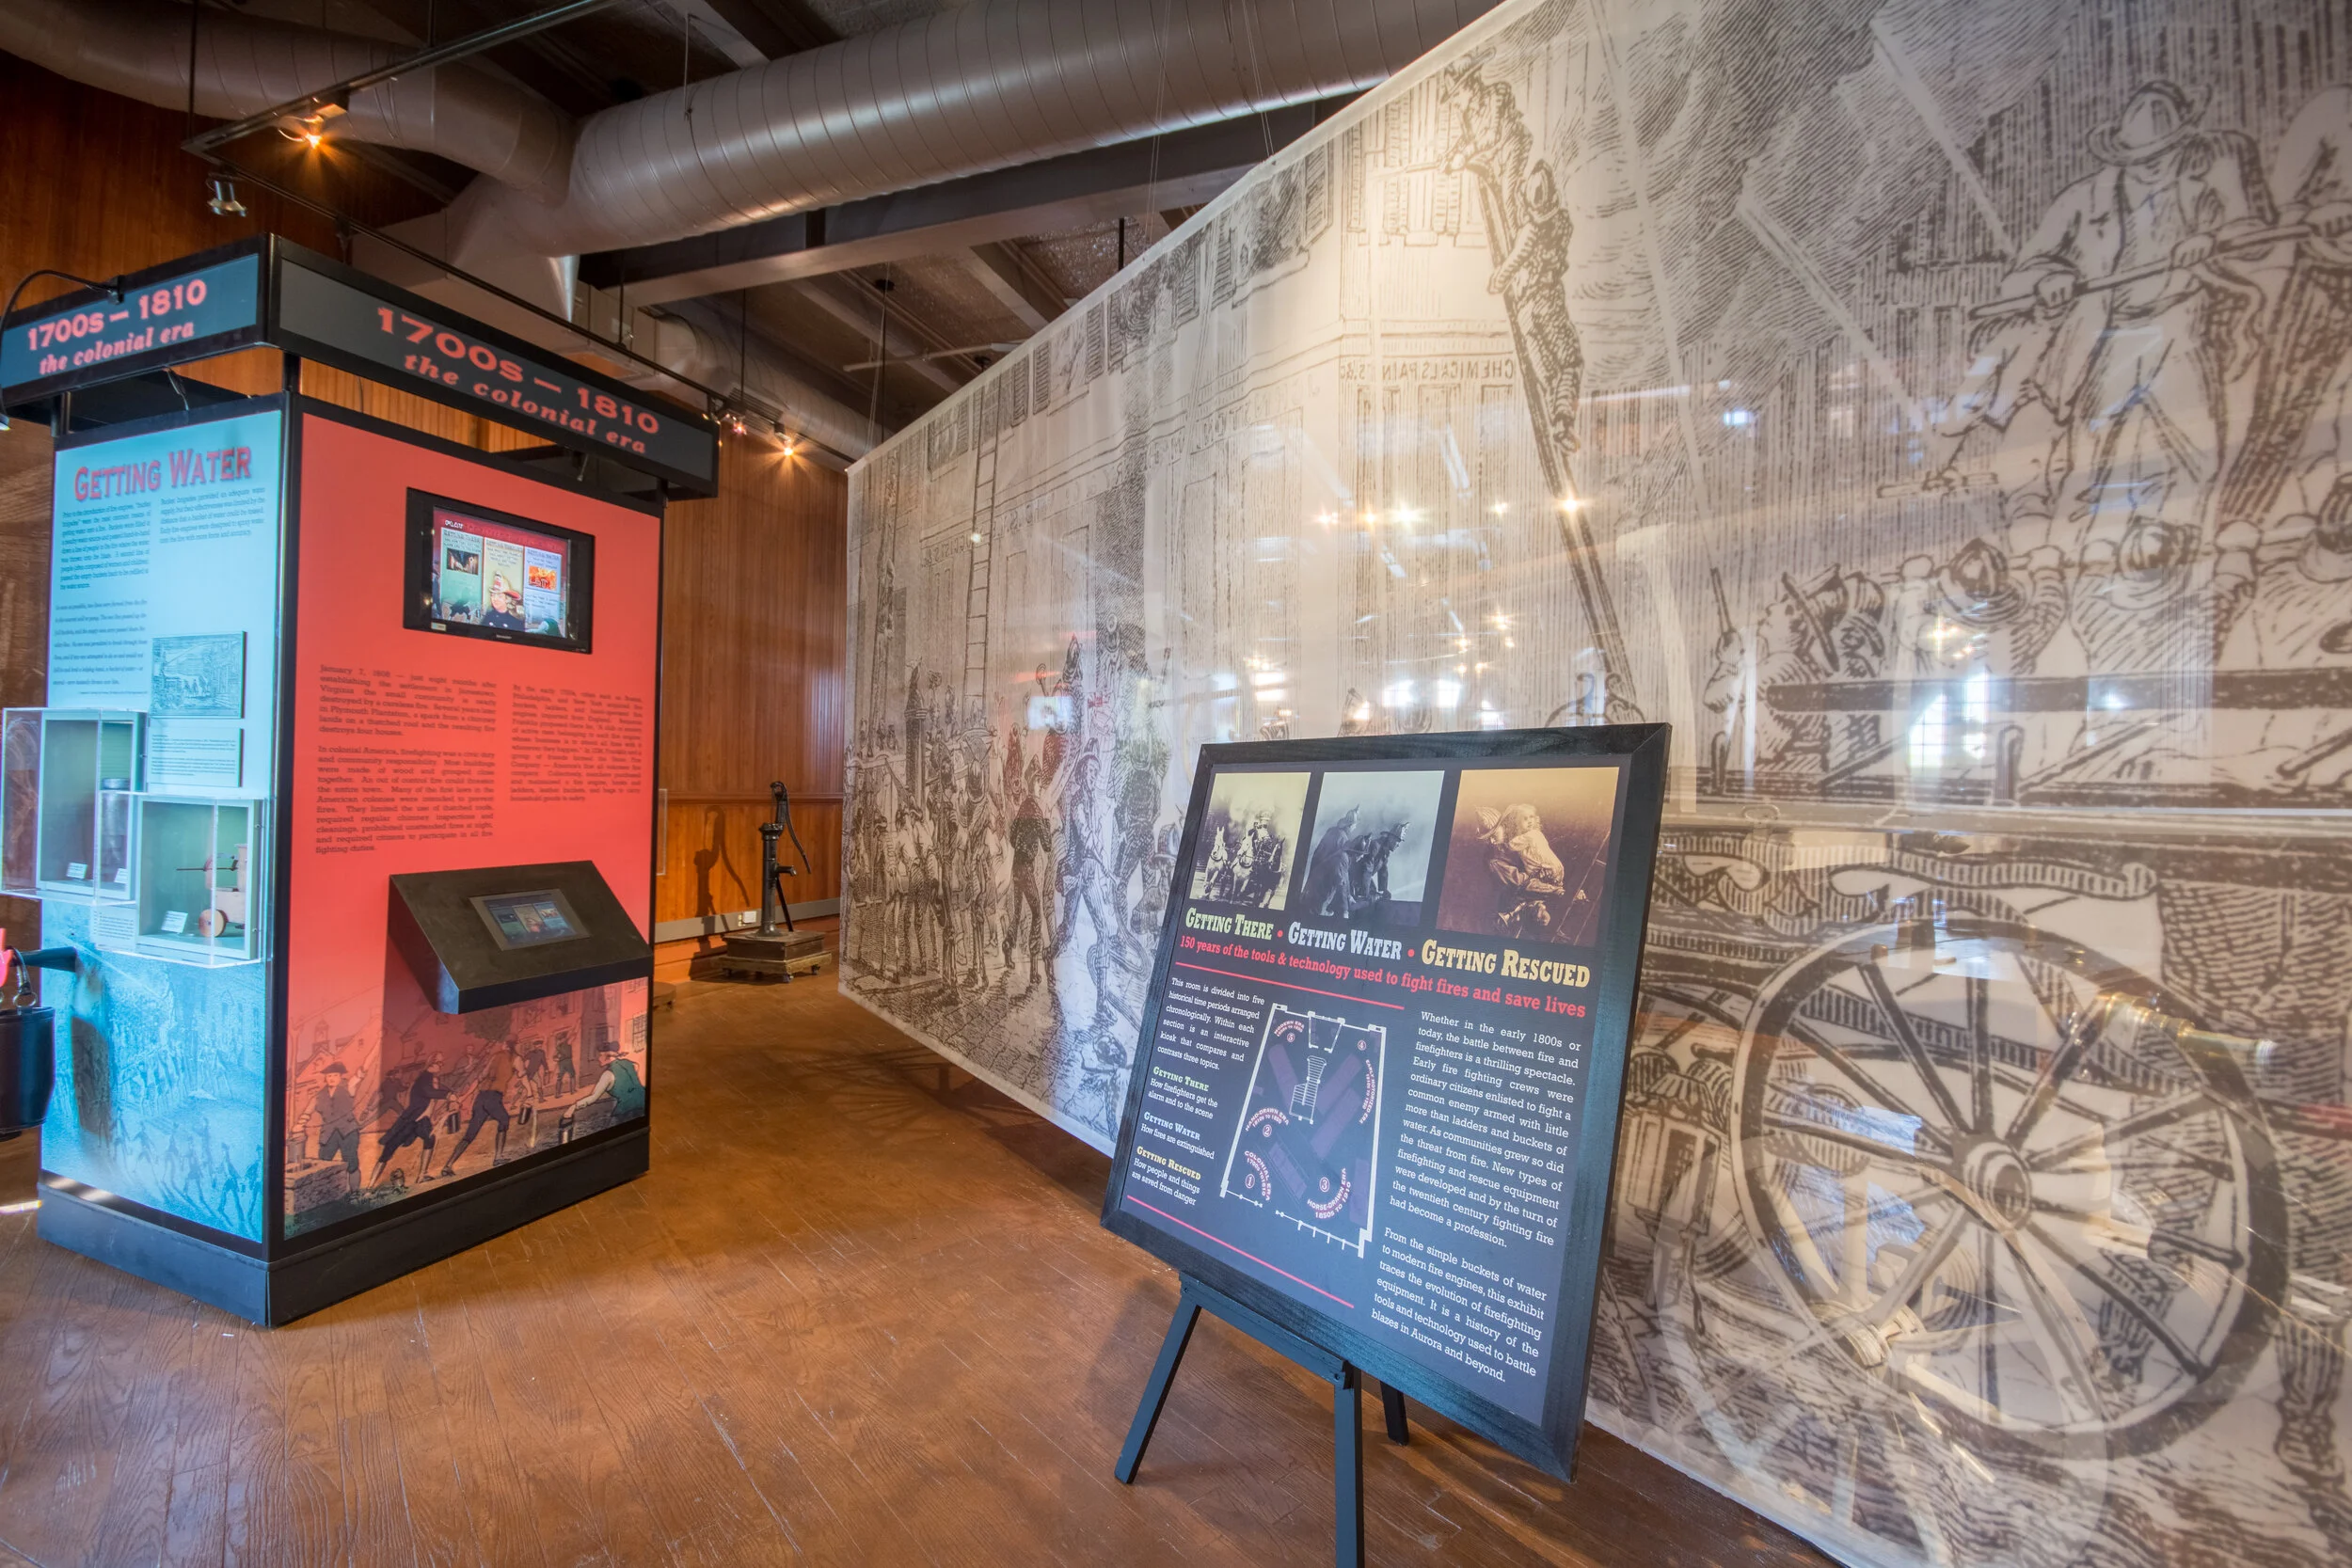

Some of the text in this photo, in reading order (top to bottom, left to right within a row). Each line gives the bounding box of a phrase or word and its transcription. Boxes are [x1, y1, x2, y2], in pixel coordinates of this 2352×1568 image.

[138, 279, 207, 320] 1810
[40, 322, 195, 375] the colonial era
[404, 354, 646, 454] the colonial era
[577, 387, 660, 435] 1810
[74, 447, 252, 502] GETTING WATER
[1185, 907, 1590, 988] GETTING THERE GETTING WATER GETTING RESCUED
[1171, 976, 1265, 1006] This room is divided into five
[1180, 935, 1585, 1018] 150 years of the tools & technology used to fight fires and save lives
[1165, 1004, 1254, 1034] chronologically. Within each
[1168, 990, 1260, 1020] historical time periods arranged
[1159, 1030, 1245, 1062] kiosk that compares and
[1162, 1019, 1249, 1048] section is an interactive
[1418, 1027, 1579, 1069] today, the battle between fire and
[1421, 1010, 1581, 1052] Whether in the early 1800s or
[1152, 1066, 1209, 1092] GETTING THERE
[1156, 1045, 1219, 1070] contrasts three topics.
[1412, 1055, 1574, 1103] Early fire fighting crews were
[1415, 1040, 1575, 1085] firefighters is a thrilling spectacle.
[1407, 1088, 1569, 1138] common enemy armed with little
[1409, 1073, 1571, 1121] ordinary citizens enlisted to fight a
[1143, 1111, 1200, 1141] GETTING WATER
[1136, 1146, 1200, 1180] GETTING RESCUED
[1382, 1244, 1545, 1321] to modern fire engines, this exhibit
[1384, 1227, 1548, 1301] From the simple buckets of water
[1379, 1260, 1542, 1341] traces the evolution of firefighting
